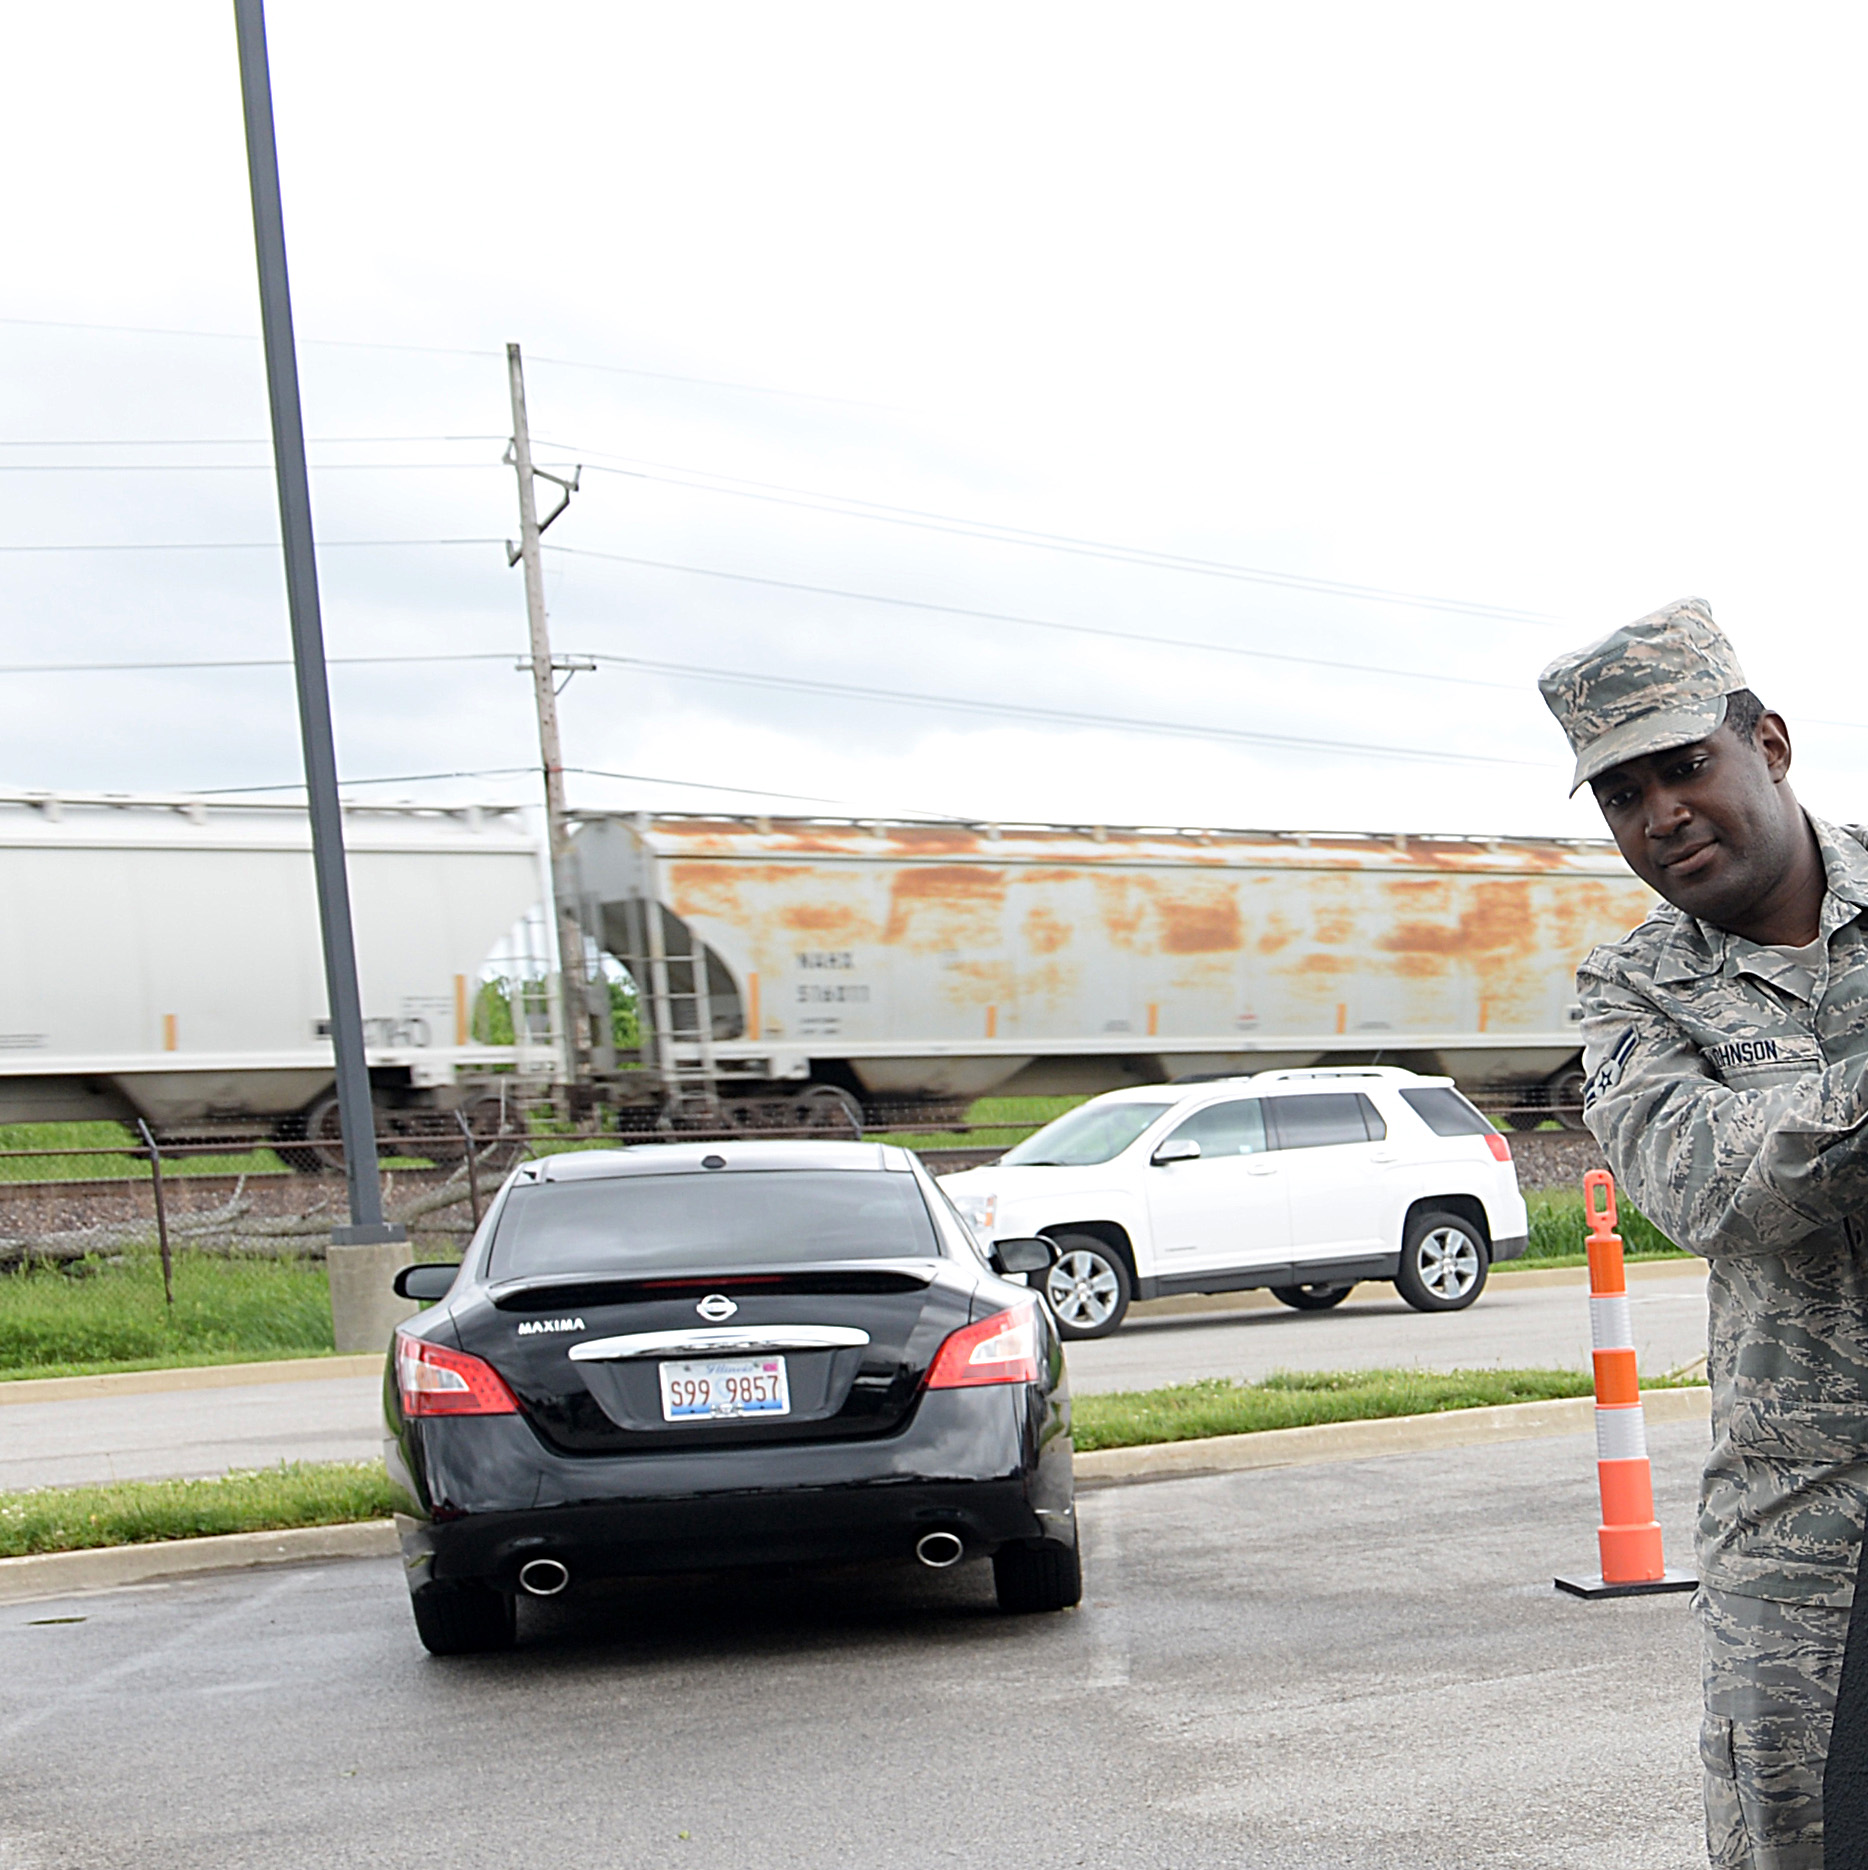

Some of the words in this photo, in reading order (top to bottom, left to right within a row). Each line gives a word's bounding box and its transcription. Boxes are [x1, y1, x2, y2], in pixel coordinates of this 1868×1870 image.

[1711, 1040, 1778, 1067] OHNSON
[518, 1317, 585, 1335] MAXIMA
[671, 1379, 710, 1407] S99
[725, 1375, 779, 1404] 9857
